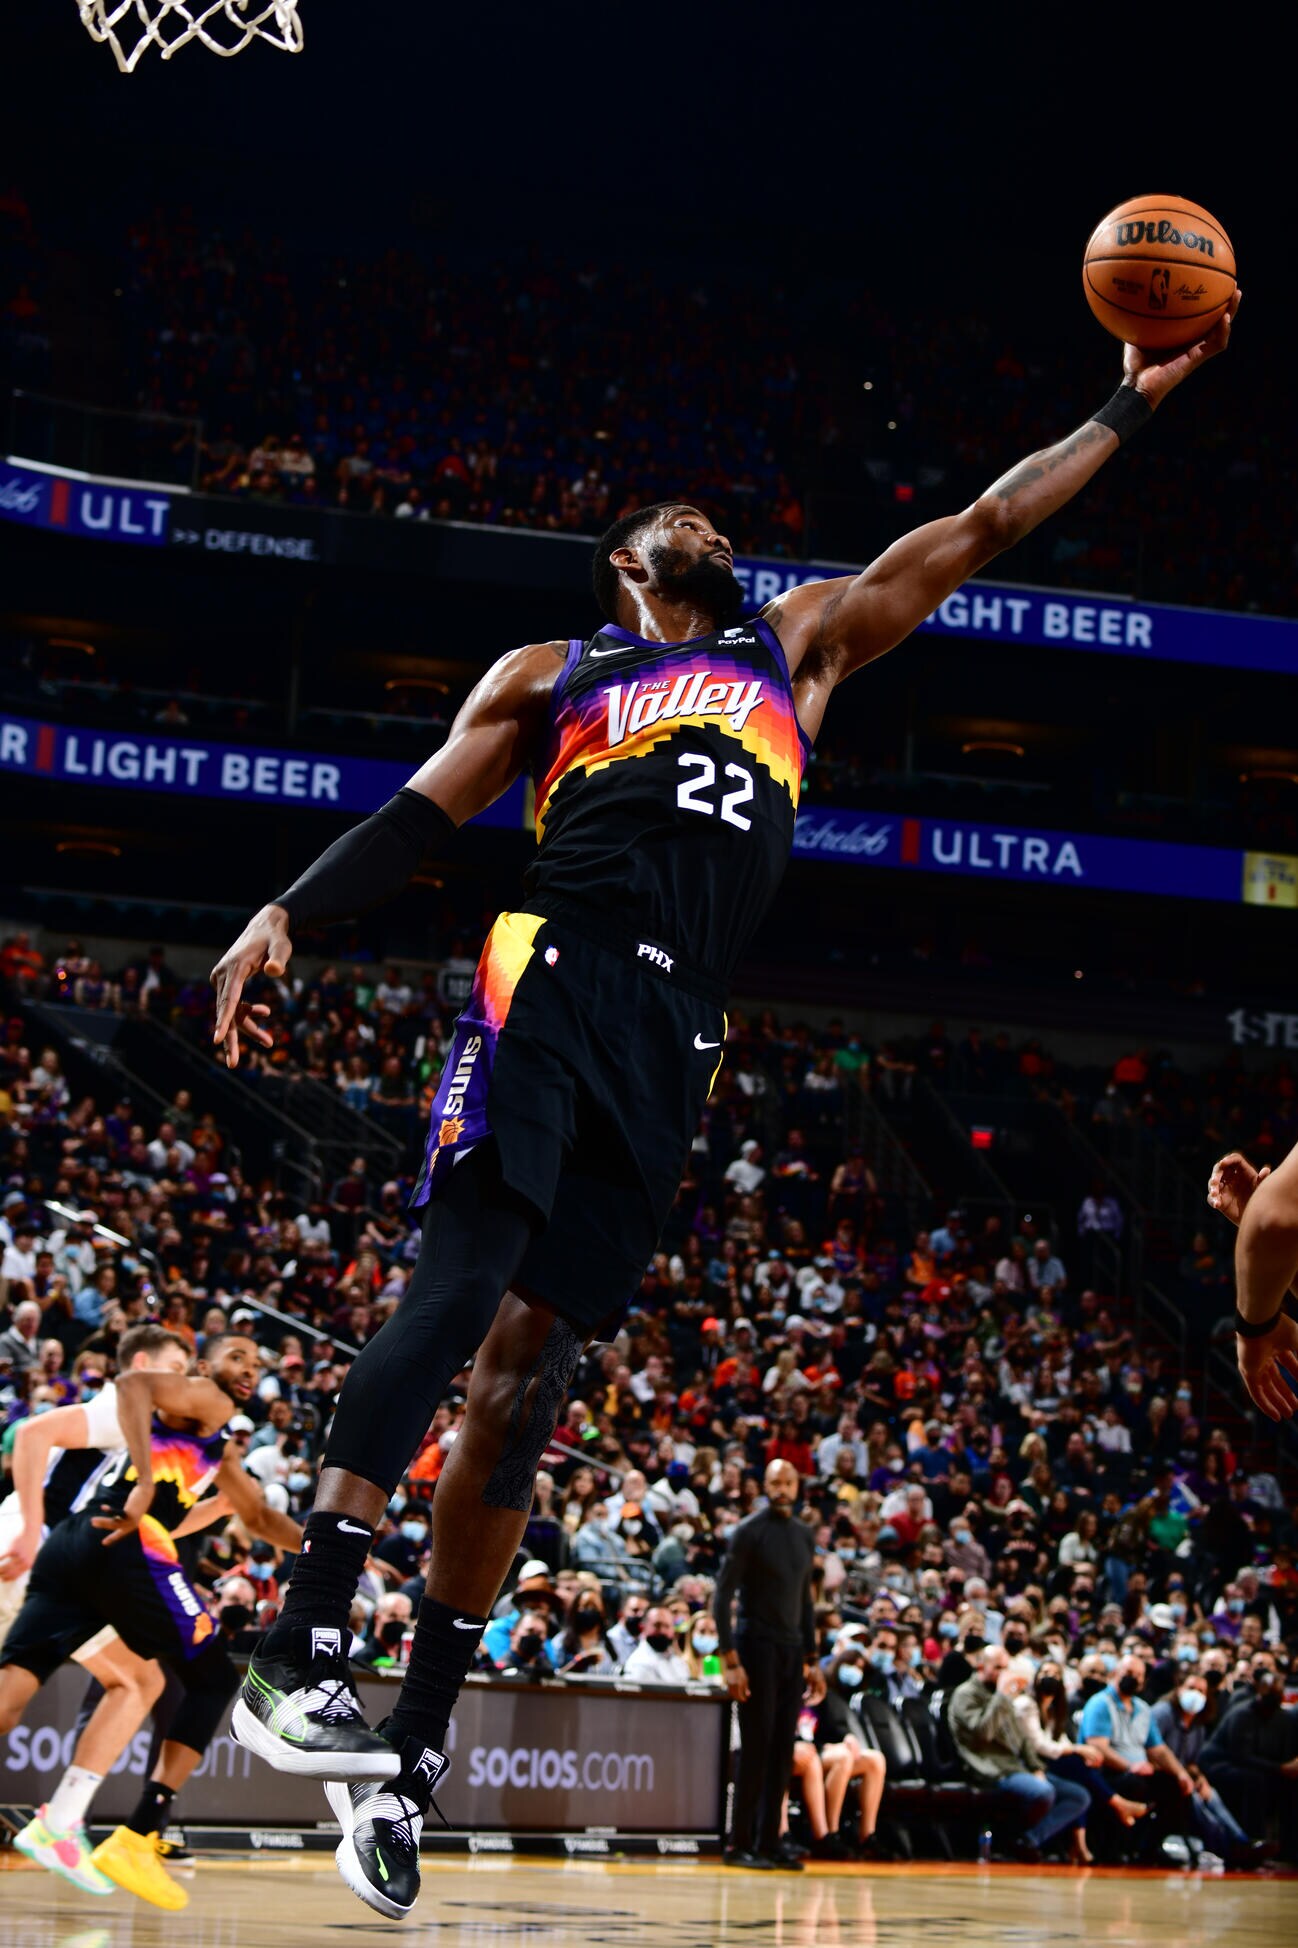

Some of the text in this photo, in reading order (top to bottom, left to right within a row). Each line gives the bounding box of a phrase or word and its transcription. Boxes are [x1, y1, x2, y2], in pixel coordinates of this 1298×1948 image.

[1116, 219, 1215, 258] Wilson
[79, 490, 171, 537] ULT
[1042, 601, 1154, 649] BEER
[603, 671, 765, 748] Valley
[642, 680, 671, 692] THE
[63, 733, 210, 788] LIGHT
[218, 751, 342, 802] BEER
[677, 752, 754, 831] 22
[931, 827, 1085, 878] ULTRA
[637, 943, 675, 974] PHX
